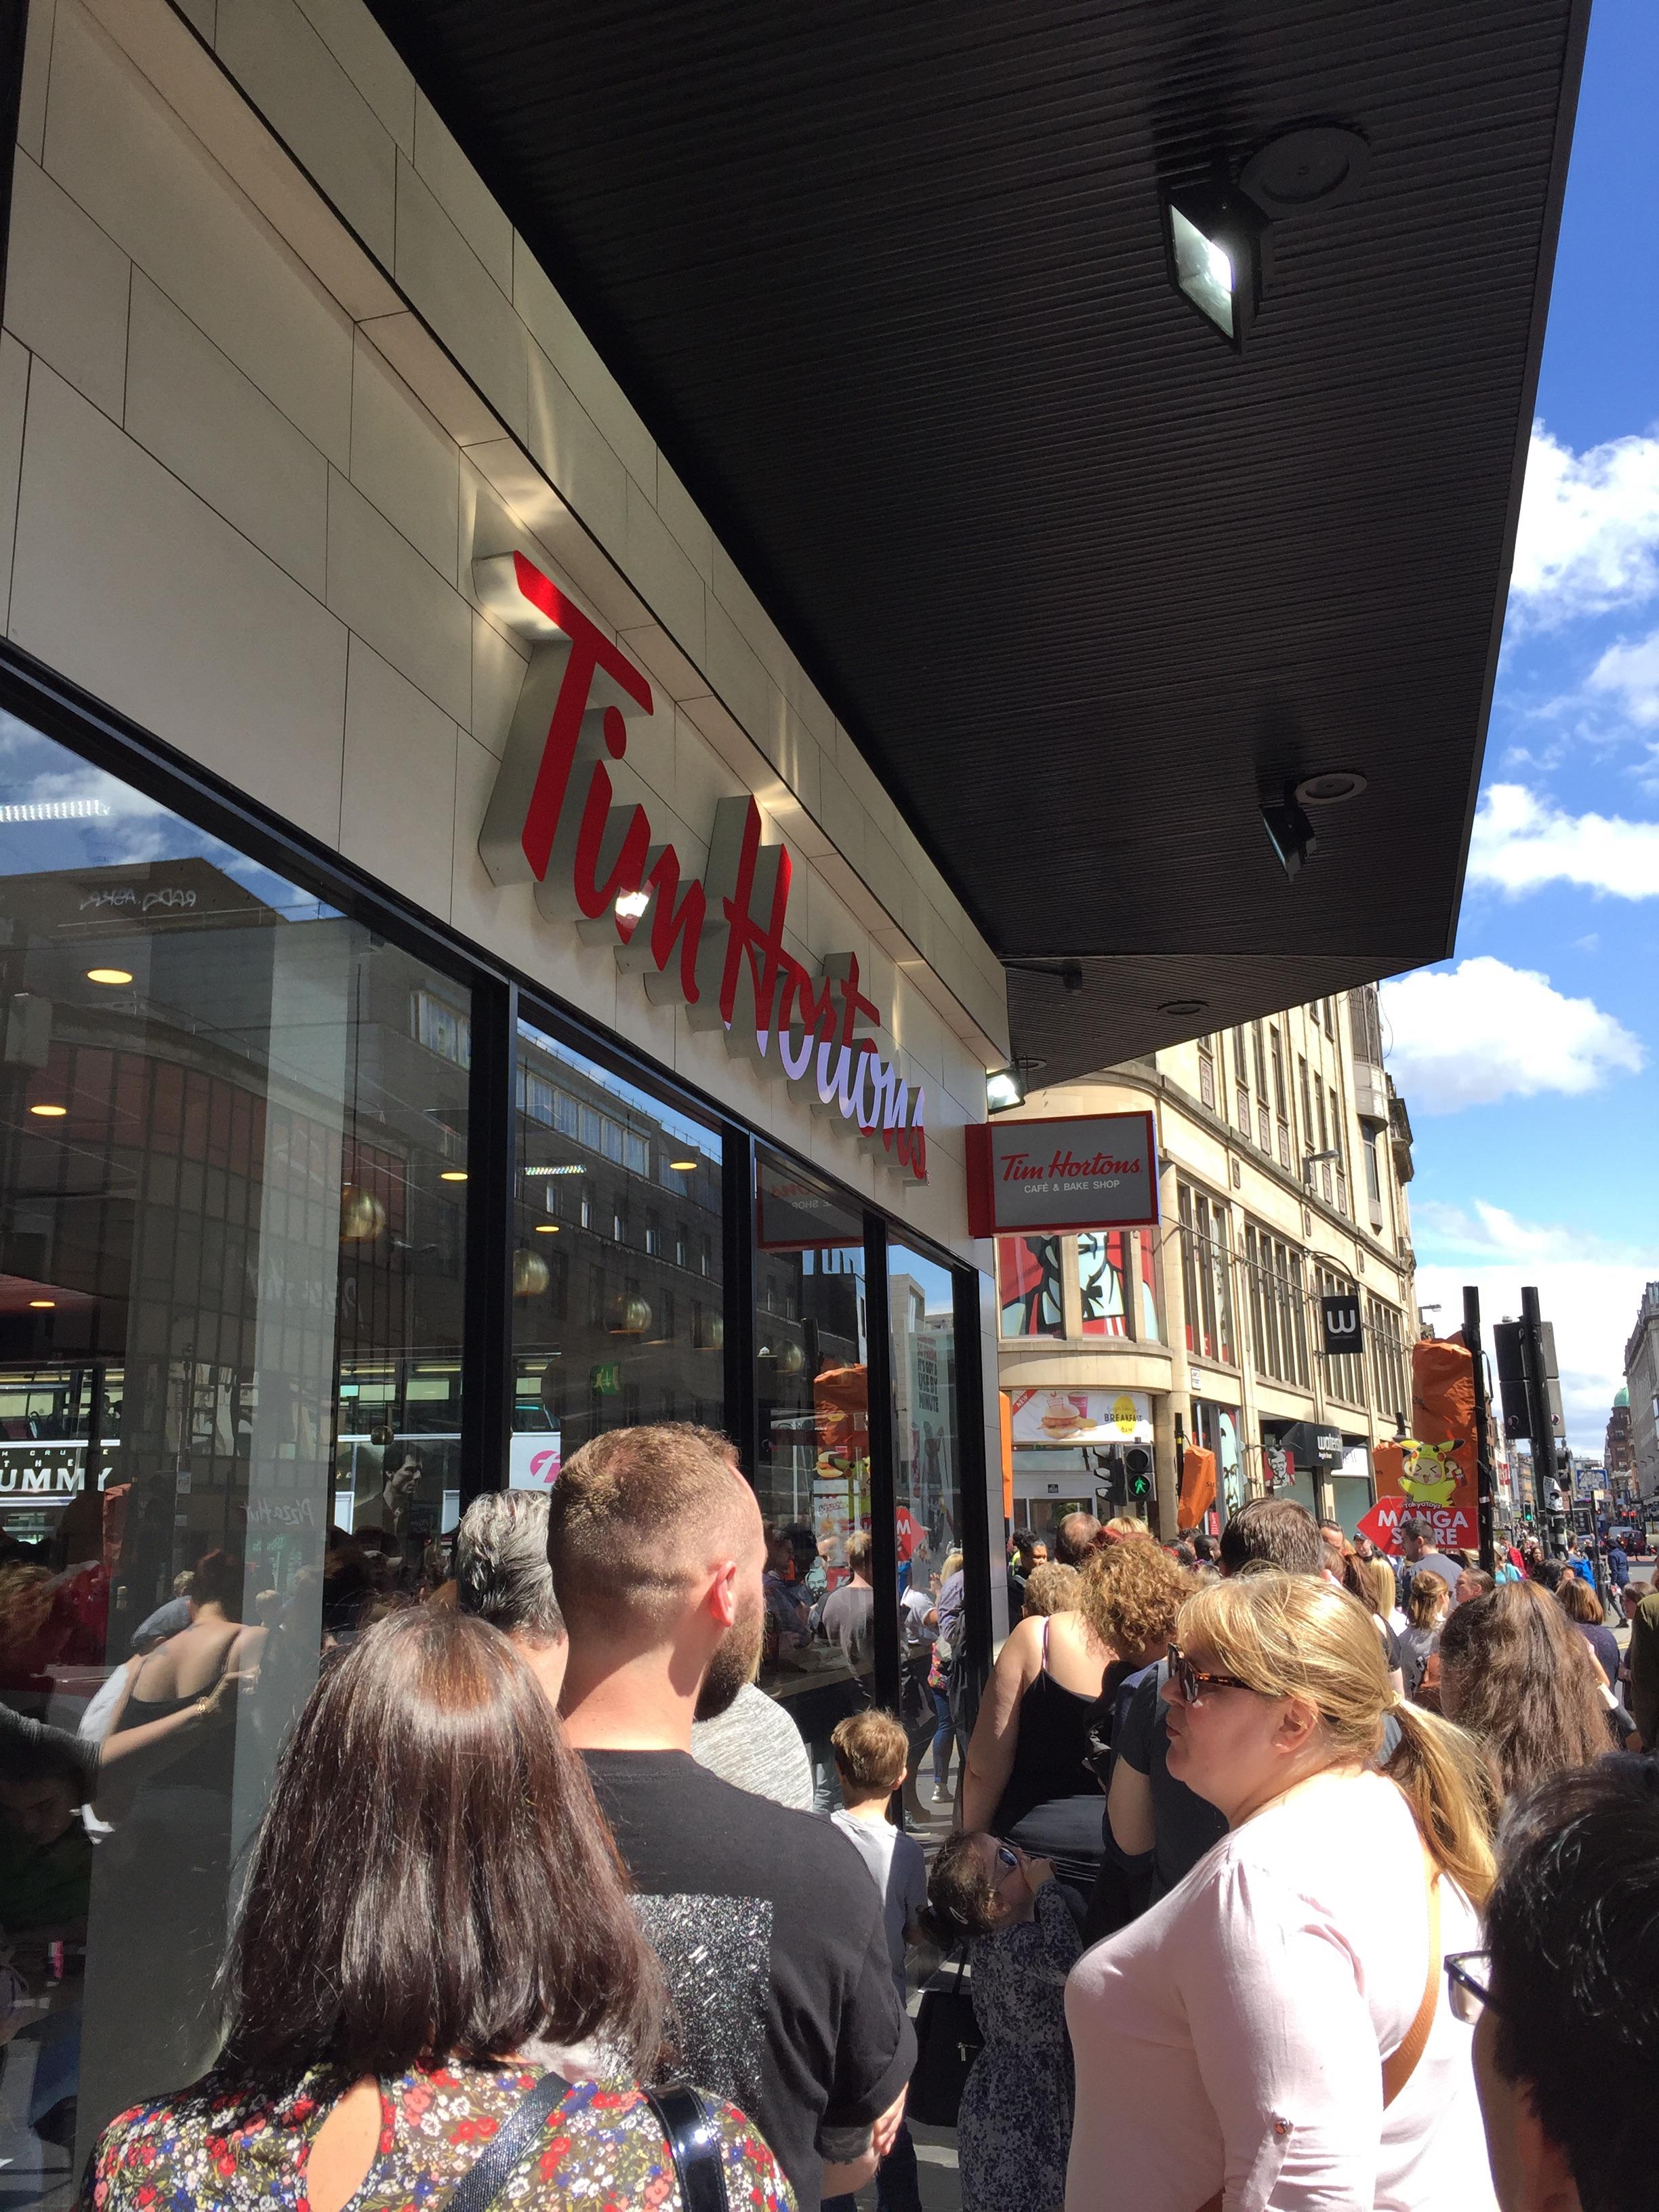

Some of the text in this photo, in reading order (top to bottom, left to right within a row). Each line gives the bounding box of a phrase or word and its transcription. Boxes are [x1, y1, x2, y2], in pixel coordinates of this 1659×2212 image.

[513, 550, 926, 1179] Tim Hortons
[1000, 1150, 1141, 1181] Tim Hortons
[1024, 1181, 1049, 1193] CAFÉ
[1063, 1181, 1089, 1191] BAKE
[1093, 1180, 1120, 1189] SHOP
[1016, 1393, 1028, 1408] NEW
[0, 1467, 113, 1492] UMMY
[1378, 1509, 1469, 1528] MANGA
[1391, 1527, 1457, 1545] SRE
